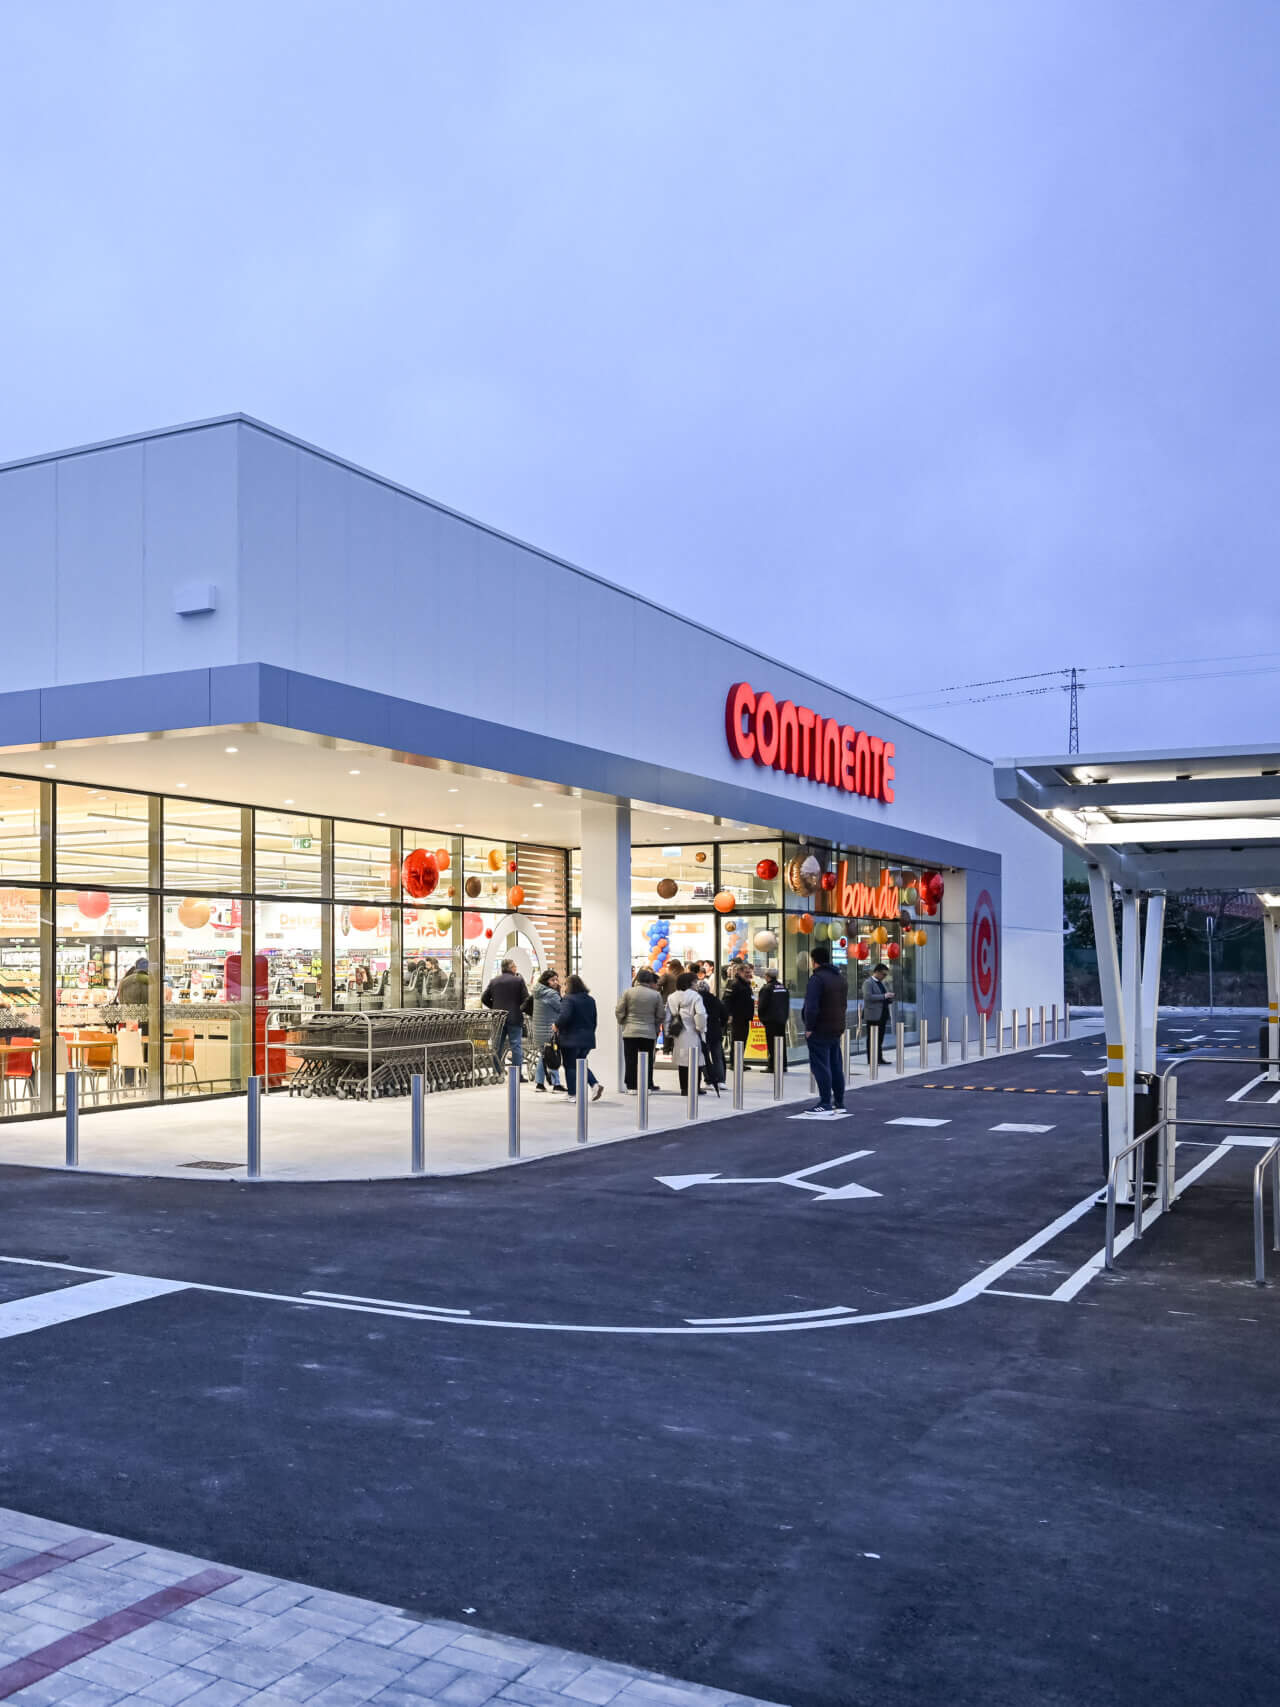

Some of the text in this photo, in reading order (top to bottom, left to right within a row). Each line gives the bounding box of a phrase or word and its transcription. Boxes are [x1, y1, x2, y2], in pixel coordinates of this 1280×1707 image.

[726, 682, 895, 804] CONTINENTE
[840, 860, 901, 919] bom dia
